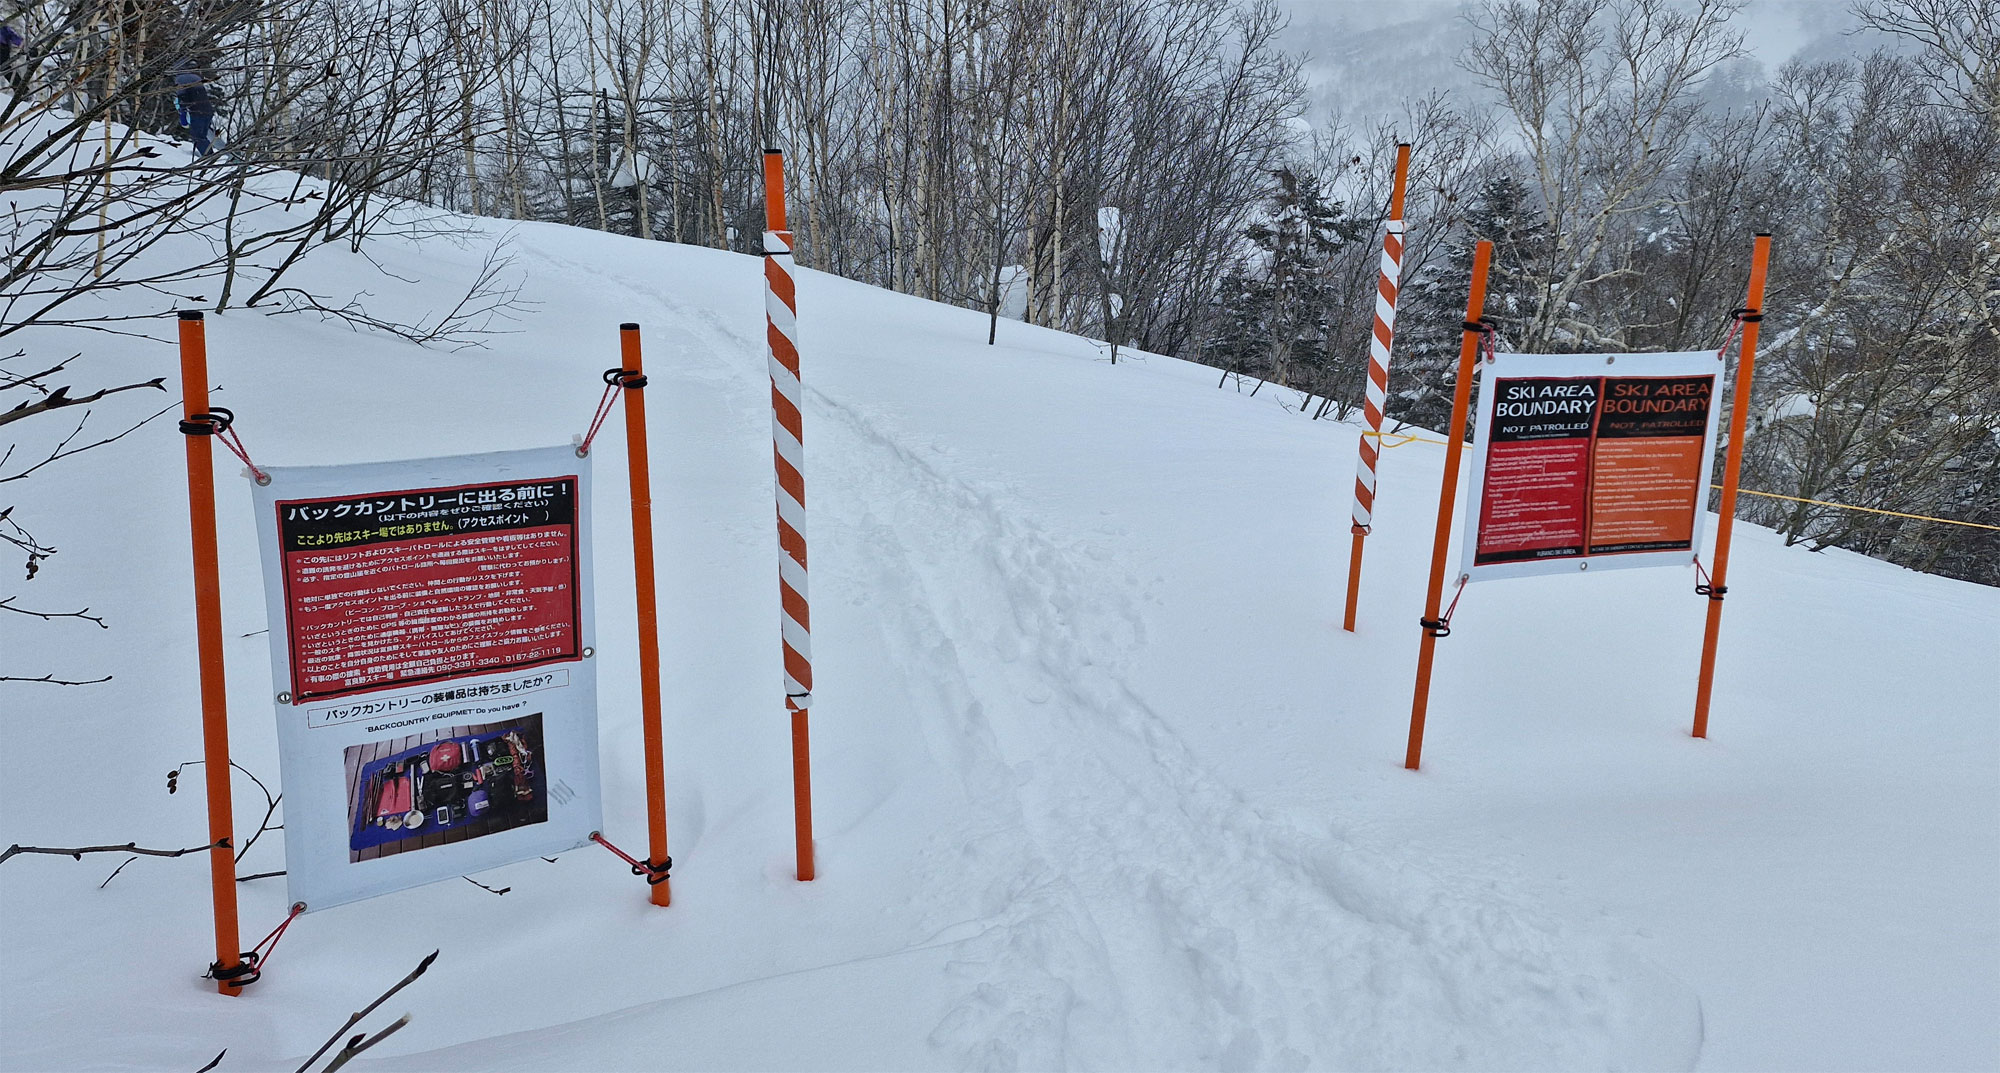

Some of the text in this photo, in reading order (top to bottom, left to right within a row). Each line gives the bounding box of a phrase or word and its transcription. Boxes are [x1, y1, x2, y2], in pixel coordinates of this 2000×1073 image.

[1507, 385, 1595, 399] SKI AREA
[1614, 383, 1709, 396] SKI AREA
[1496, 400, 1597, 417] BOUNDARY
[1603, 398, 1711, 414] BOUNDARY
[1503, 422, 1589, 433] NOT PATROLLED
[1610, 420, 1704, 430] NOT PATROLLED
[288, 483, 567, 521] バックカントリーに出る前に！
[297, 520, 454, 546] ここより先はスキー場ではありません。
[325, 675, 553, 720] バックカントリーの装備品は持ちましたか？
[488, 706, 501, 714] you
[501, 703, 520, 711] have
